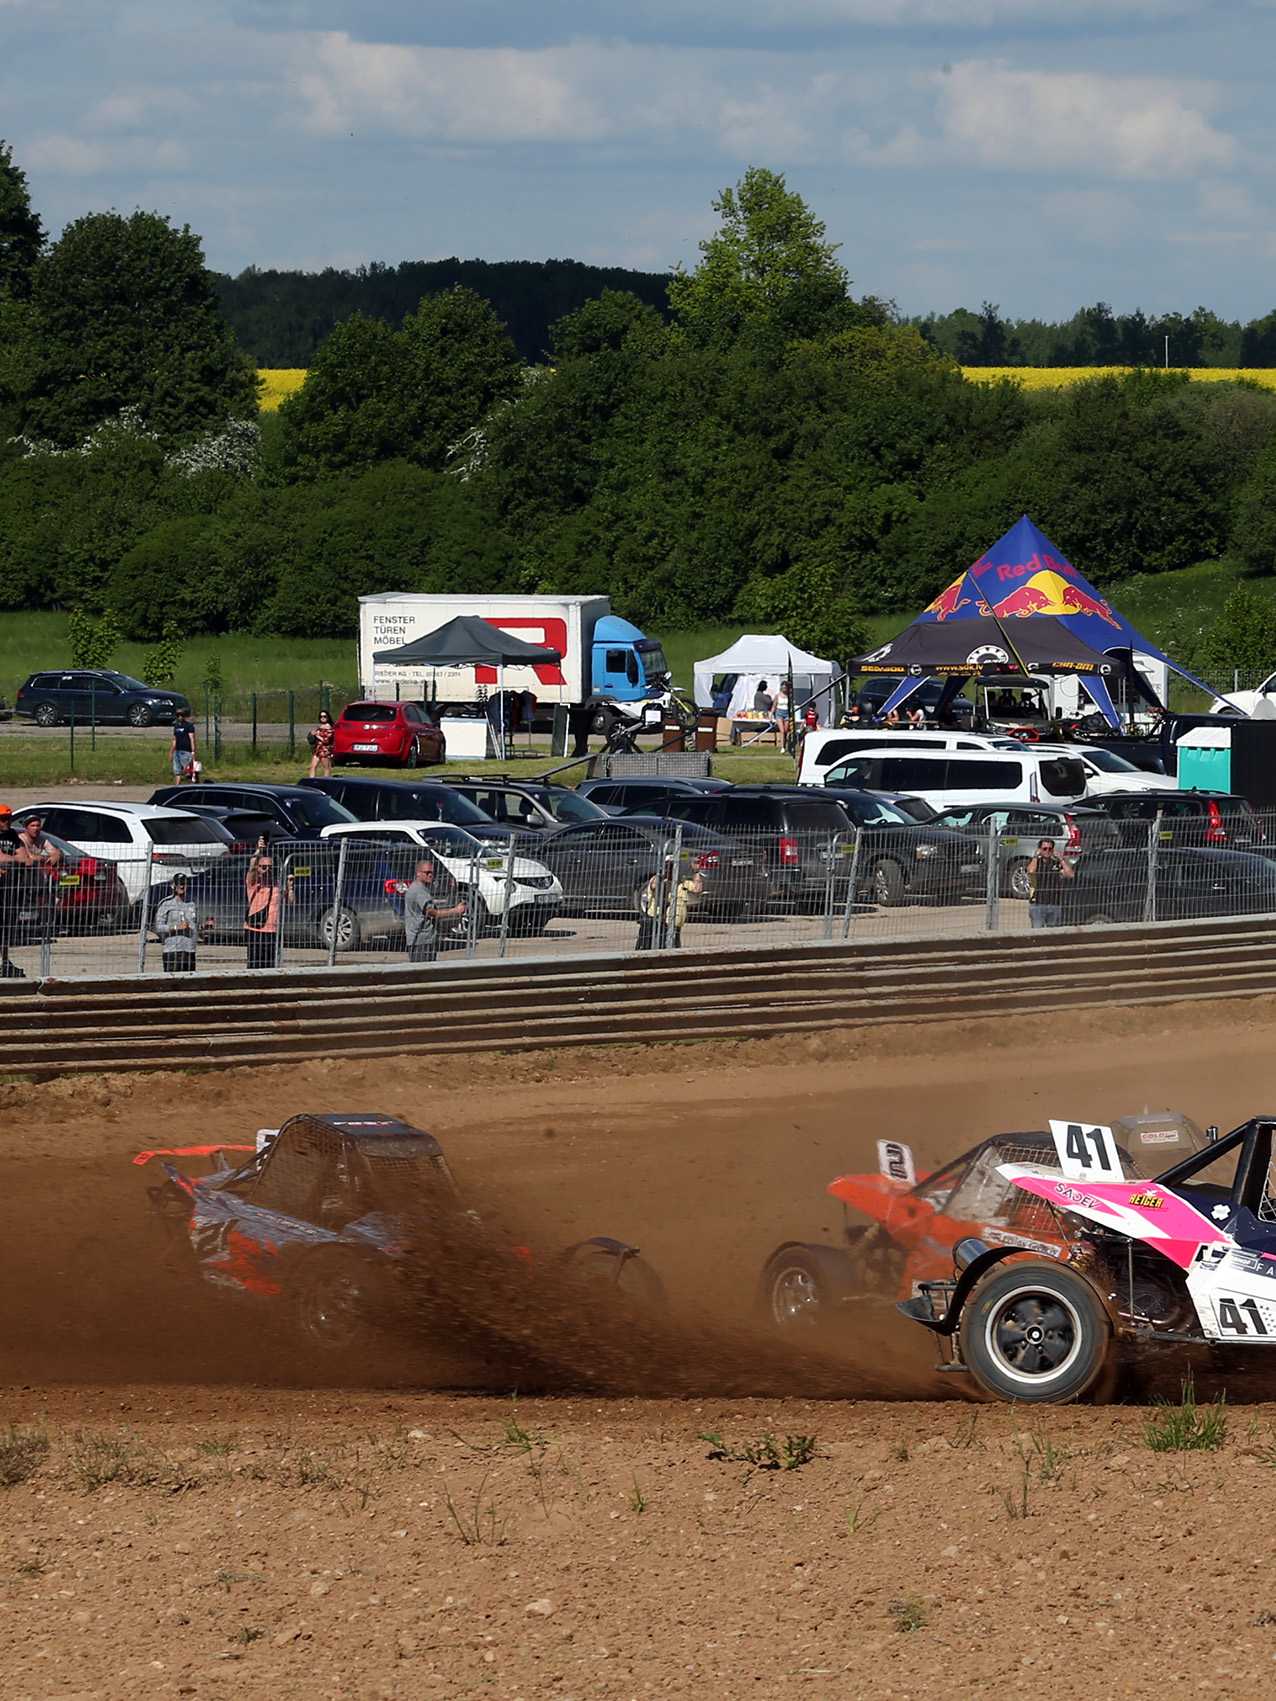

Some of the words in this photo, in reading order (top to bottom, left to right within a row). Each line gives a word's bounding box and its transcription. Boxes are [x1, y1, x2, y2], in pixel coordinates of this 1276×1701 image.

[997, 553, 1042, 581] Red
[1042, 554, 1079, 579] Bull
[373, 616, 415, 624] FENSTER
[374, 625, 406, 634] TÜREN
[374, 635, 407, 645] MÖBEL
[1066, 1125, 1112, 1171] 41
[1055, 1182, 1101, 1209] SADEV
[1129, 1194, 1165, 1207] REIGER
[1218, 1298, 1268, 1335] 41
